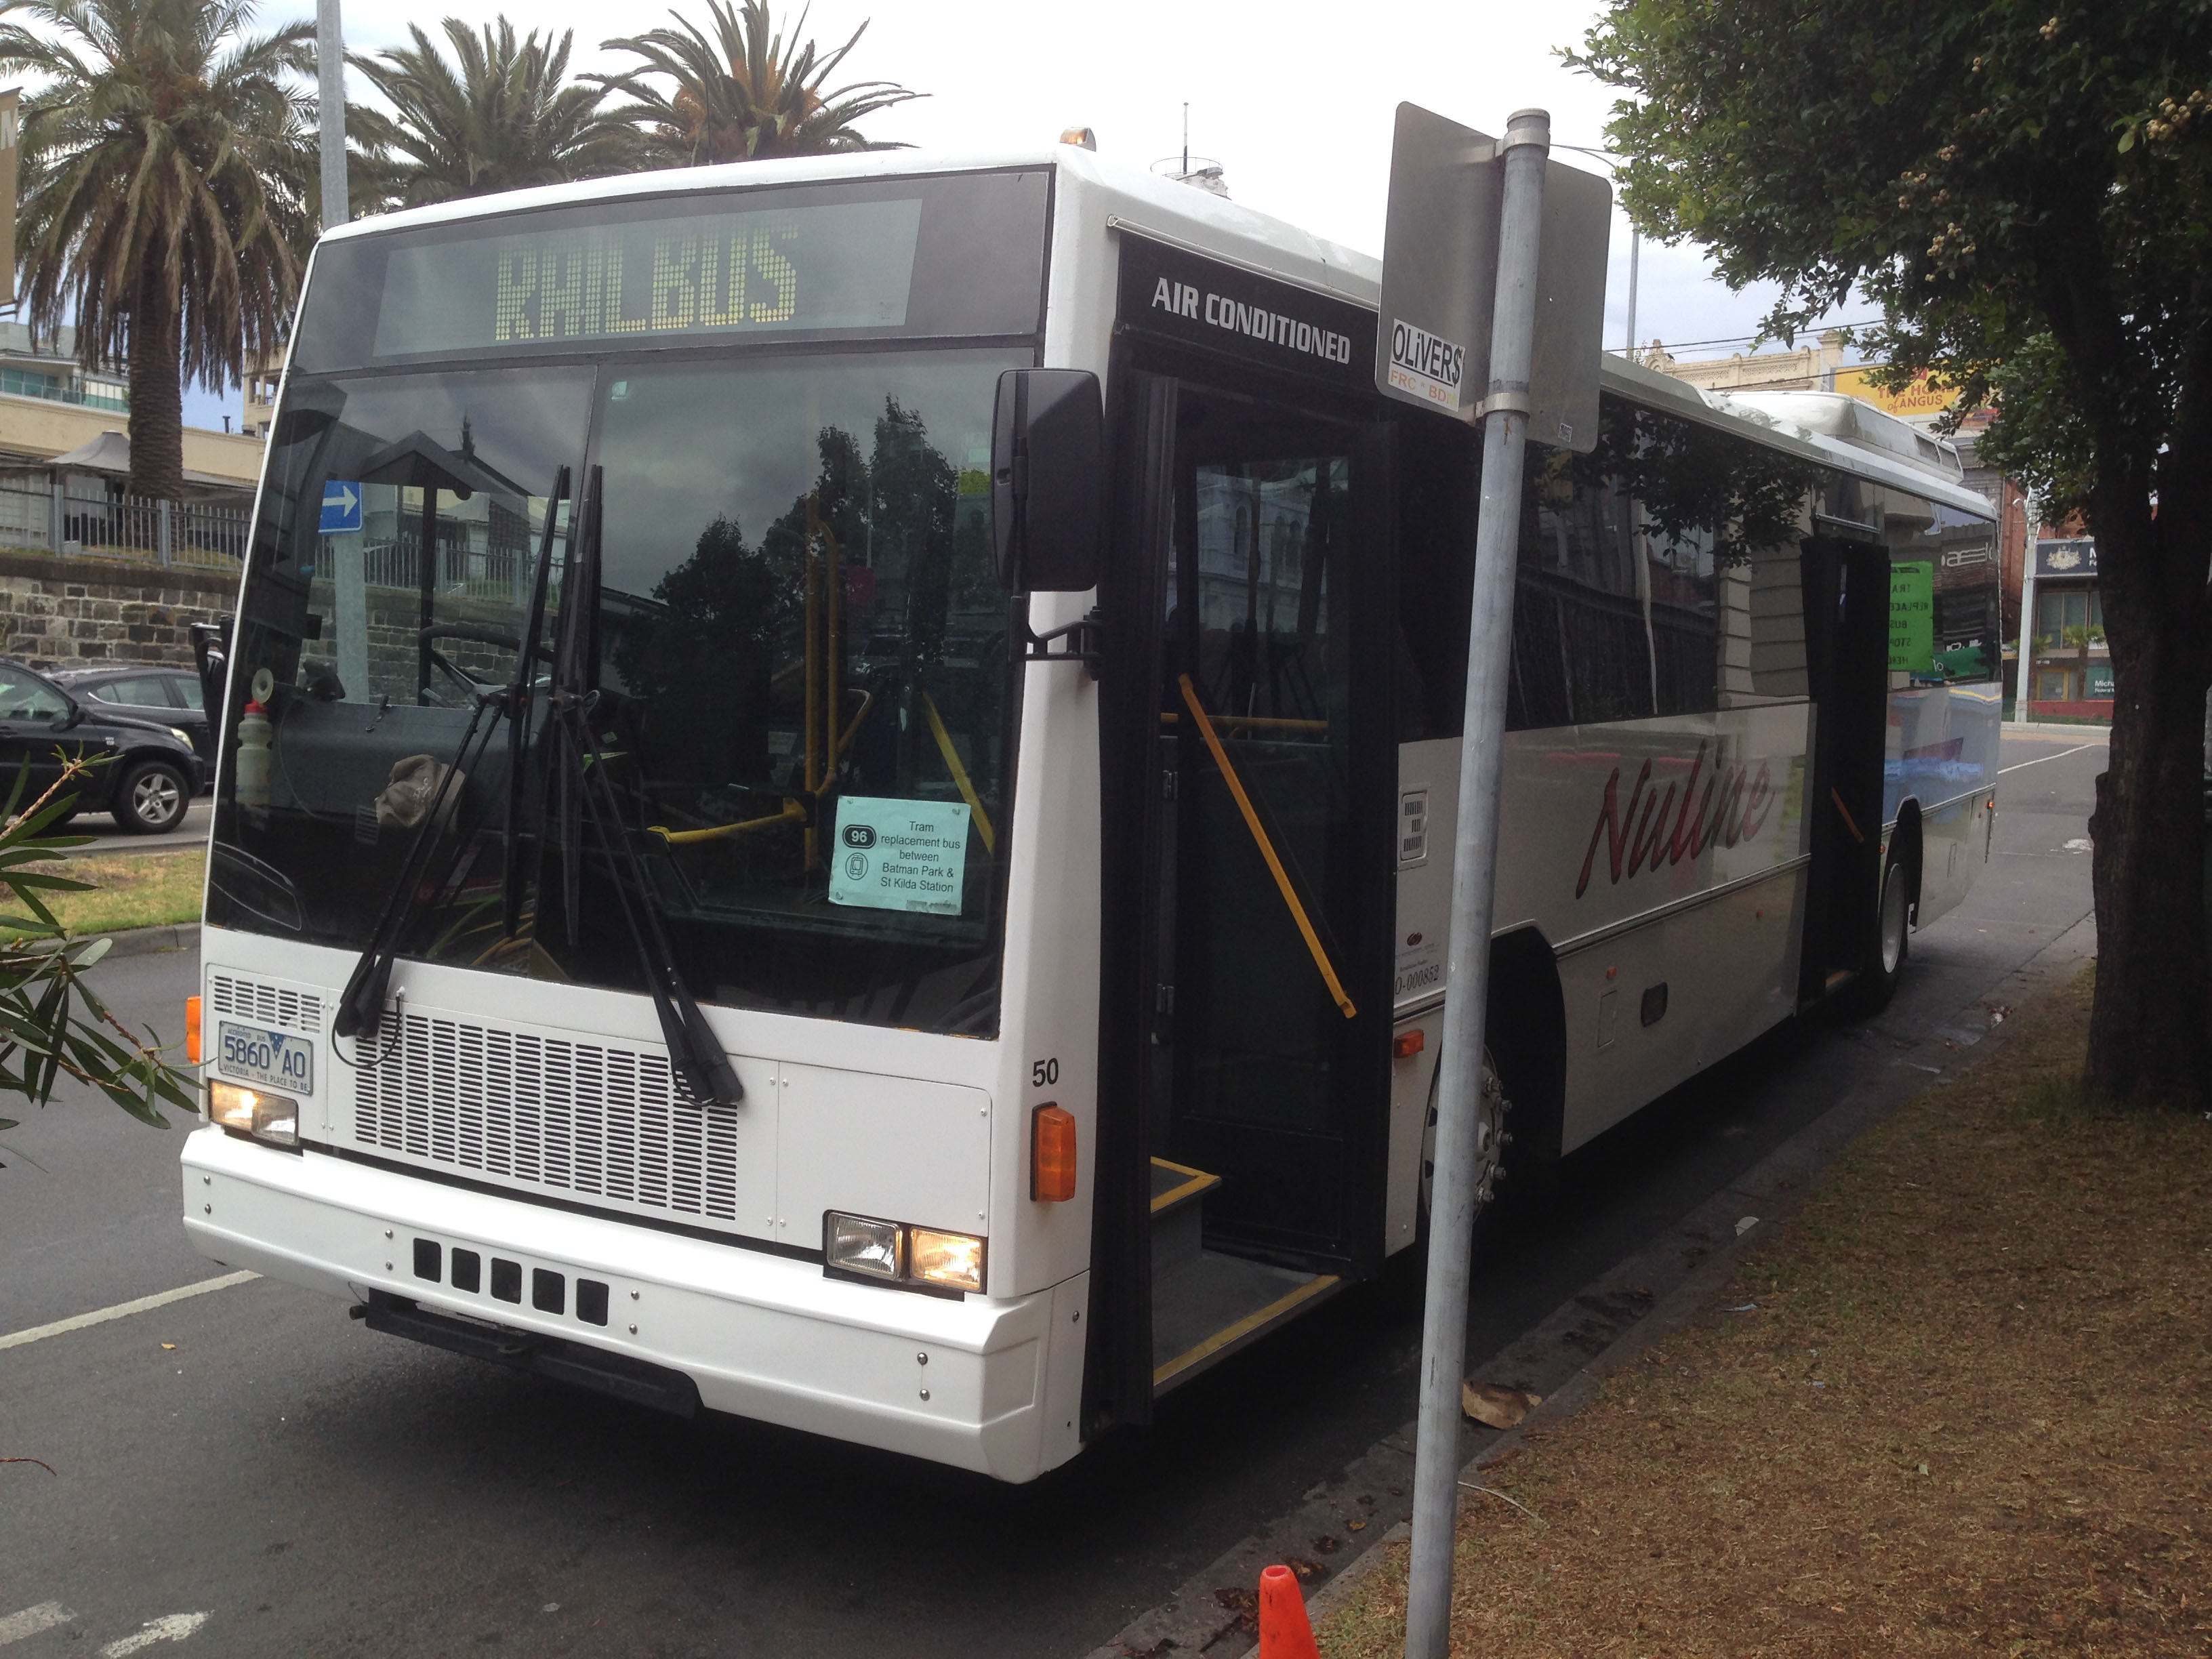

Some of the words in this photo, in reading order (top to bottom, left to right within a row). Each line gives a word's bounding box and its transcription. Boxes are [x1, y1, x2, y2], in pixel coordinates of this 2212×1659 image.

[1151, 276, 1199, 319] AIR
[1205, 293, 1351, 365] CONDITIONED
[1391, 370, 1416, 391] FRC
[1887, 397, 1900, 413] of
[1900, 394, 1943, 408] ANGUS
[909, 821, 935, 833] Tram
[1575, 737, 1776, 899] Nuline
[851, 830, 867, 843] 96
[881, 835, 940, 847] replacement
[943, 838, 960, 848] bus
[899, 849, 939, 862] between
[882, 863, 918, 875] Batman
[922, 865, 943, 878] Park
[946, 867, 954, 878] &
[880, 878, 891, 888] St
[894, 878, 916, 889] Kilda
[919, 880, 954, 893] Station
[225, 1035, 270, 1069] 5860
[224, 1064, 249, 1076] VICTORIA
[257, 1071, 267, 1082] THE
[270, 1076, 287, 1086] PLACE
[290, 1080, 298, 1088] TO
[1032, 1058, 1059, 1087] 50
